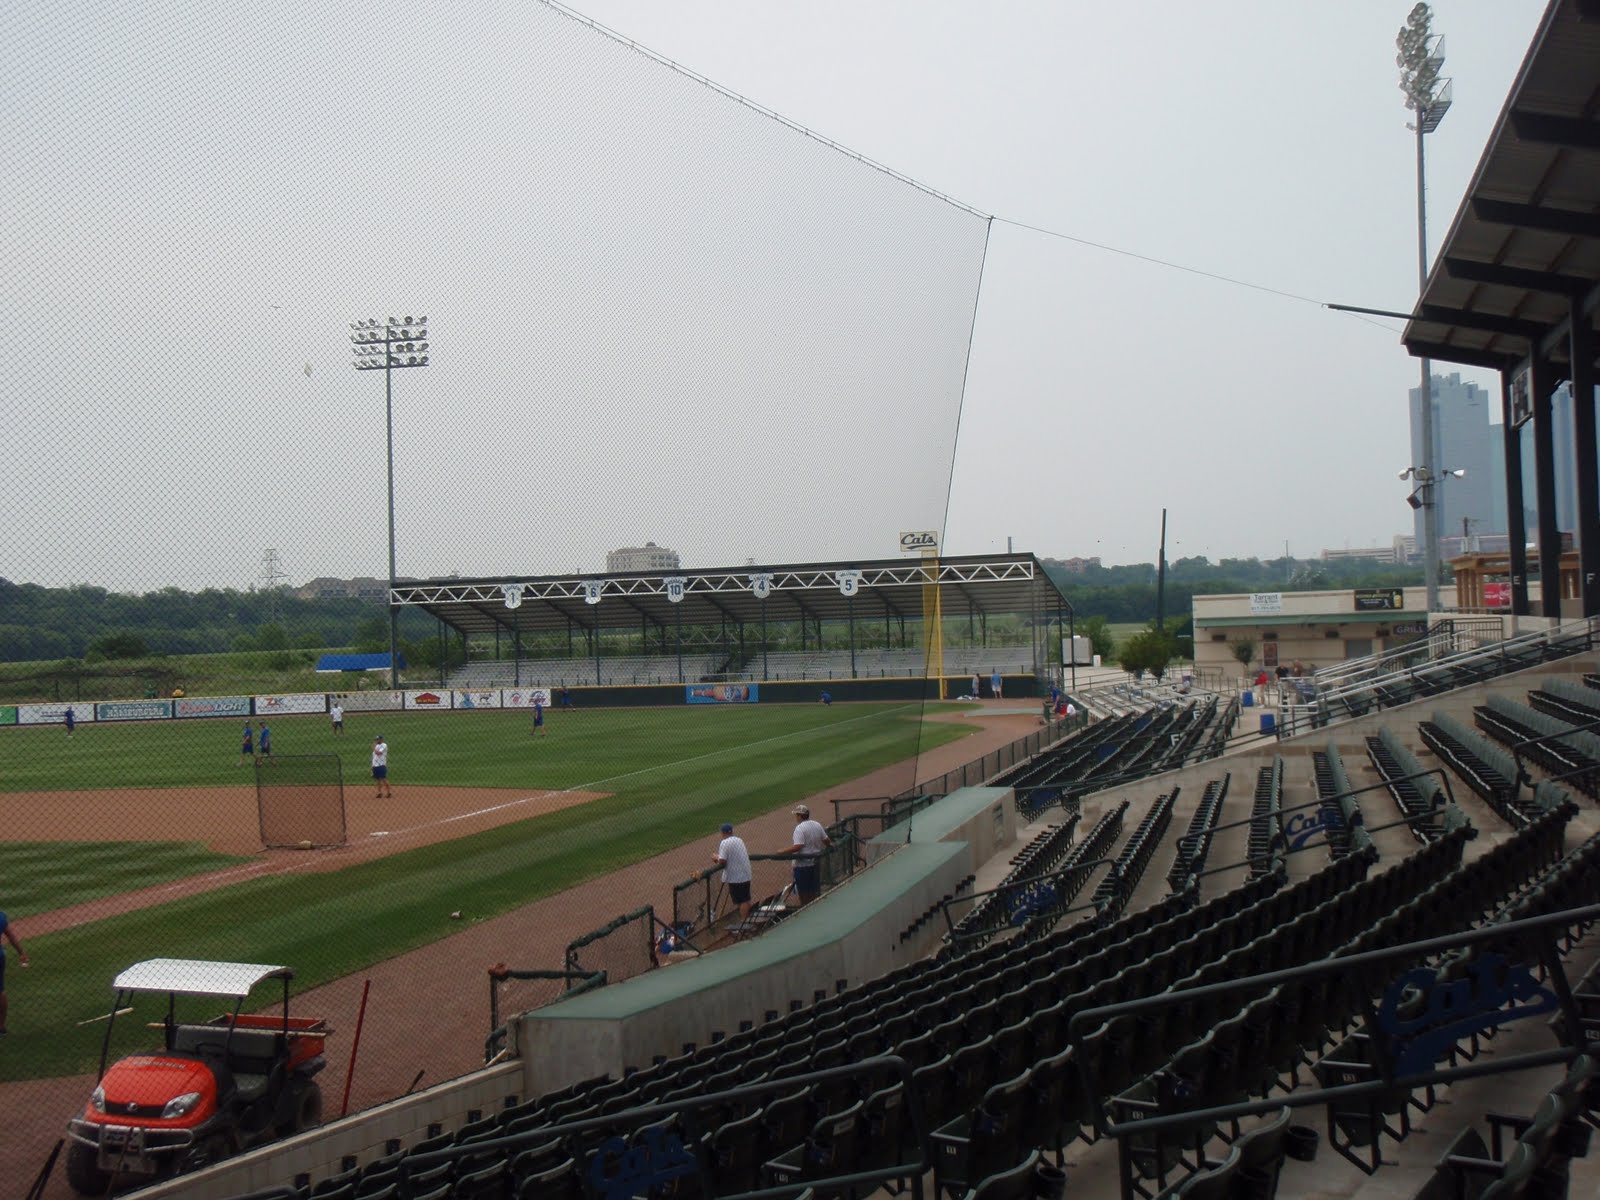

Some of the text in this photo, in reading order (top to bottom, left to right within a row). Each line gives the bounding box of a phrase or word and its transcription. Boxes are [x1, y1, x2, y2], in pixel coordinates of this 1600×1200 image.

[900, 532, 937, 549] Cats
[1513, 576, 1520, 585] E
[1586, 573, 1596, 584] F
[670, 584, 681, 595] 10
[758, 580, 765, 591] 4
[845, 579, 852, 591] 5
[590, 588, 597, 597] 6
[1396, 625, 1424, 634] GRILL
[214, 702, 244, 712] LIGHT
[1171, 734, 1180, 746] F
[1378, 952, 1560, 1065] Cats
